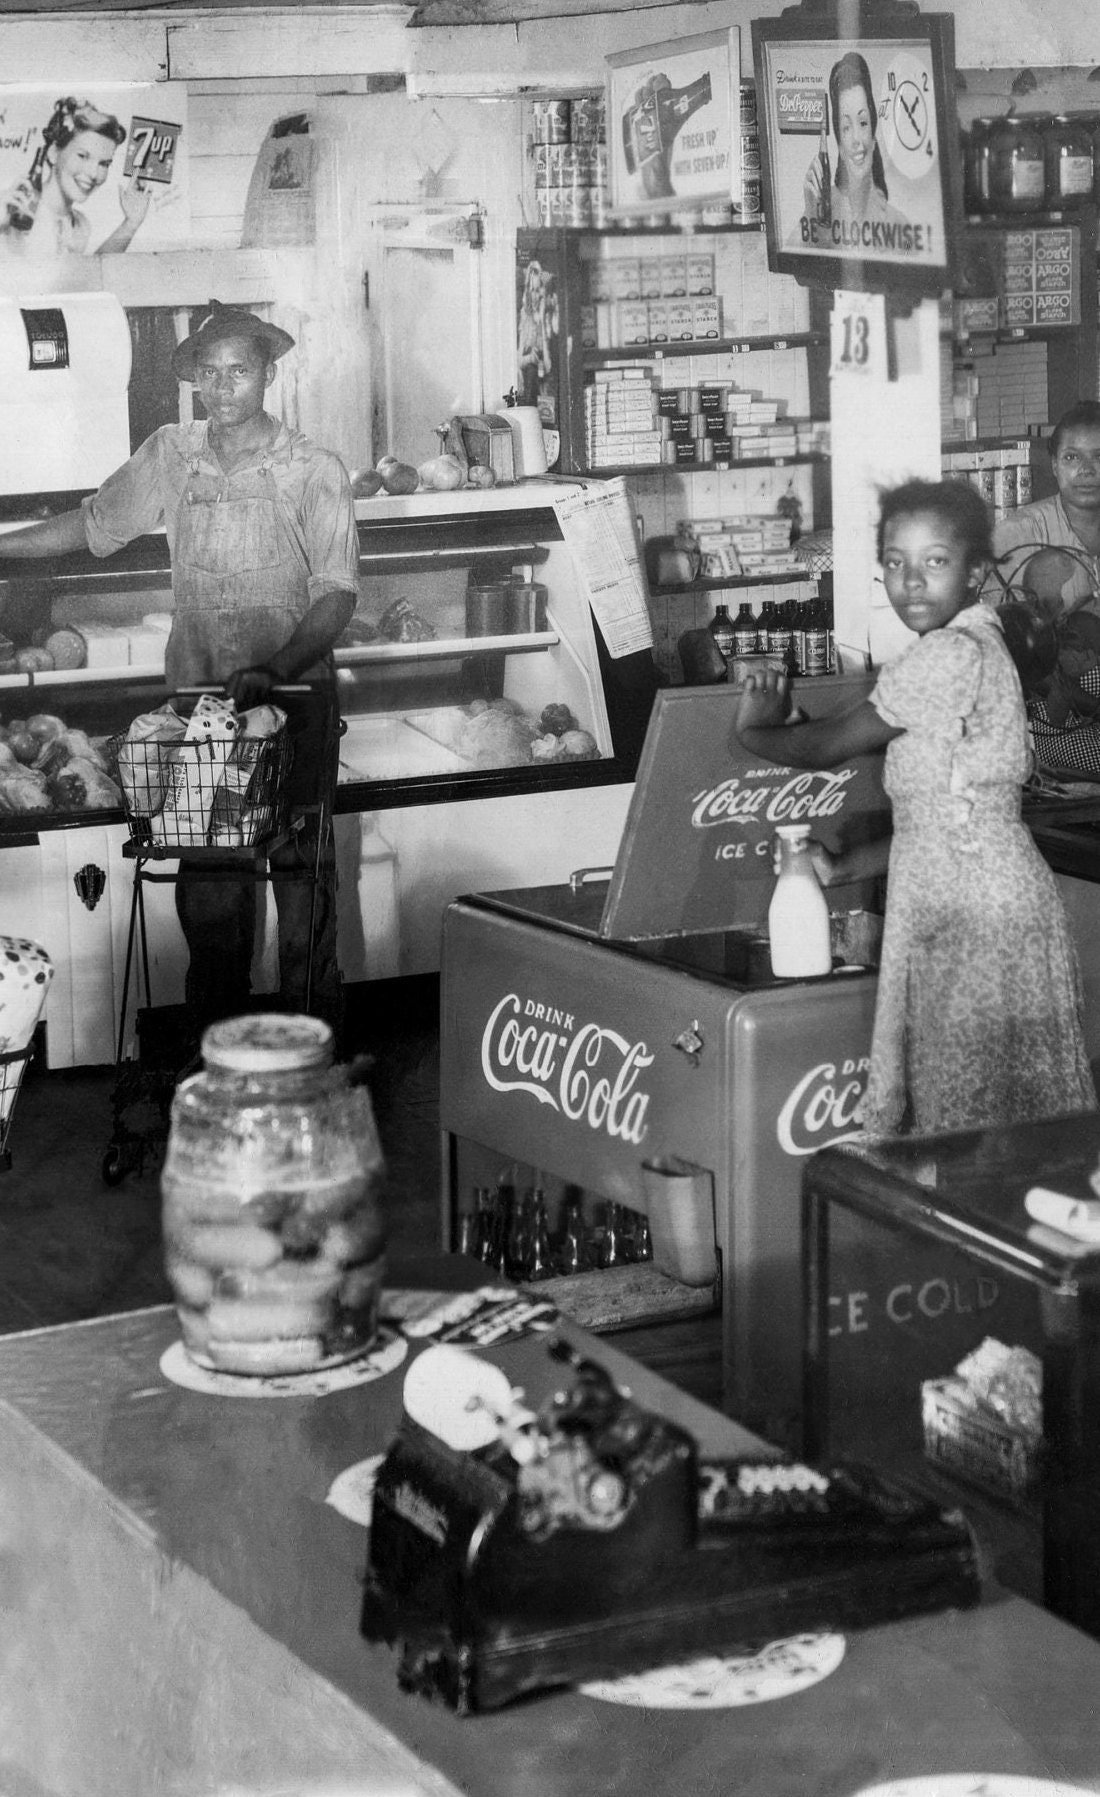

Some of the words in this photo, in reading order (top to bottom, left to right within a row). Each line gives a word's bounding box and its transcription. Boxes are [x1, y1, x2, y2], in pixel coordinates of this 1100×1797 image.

[887, 71, 897, 92] 10
[921, 71, 929, 92] 2
[878, 97, 892, 120] at
[925, 140, 933, 157] 4
[801, 216, 818, 243] BE
[1037, 264, 1070, 277] ARGO
[1037, 295, 1070, 308] ARGO
[840, 314, 870, 365] 13
[744, 767, 792, 779] DRINK
[715, 842, 745, 860] ICE
[524, 998, 576, 1031] DRINK
[481, 992, 655, 1145] Coca-Cola
[886, 1276, 1000, 1324] COLD
